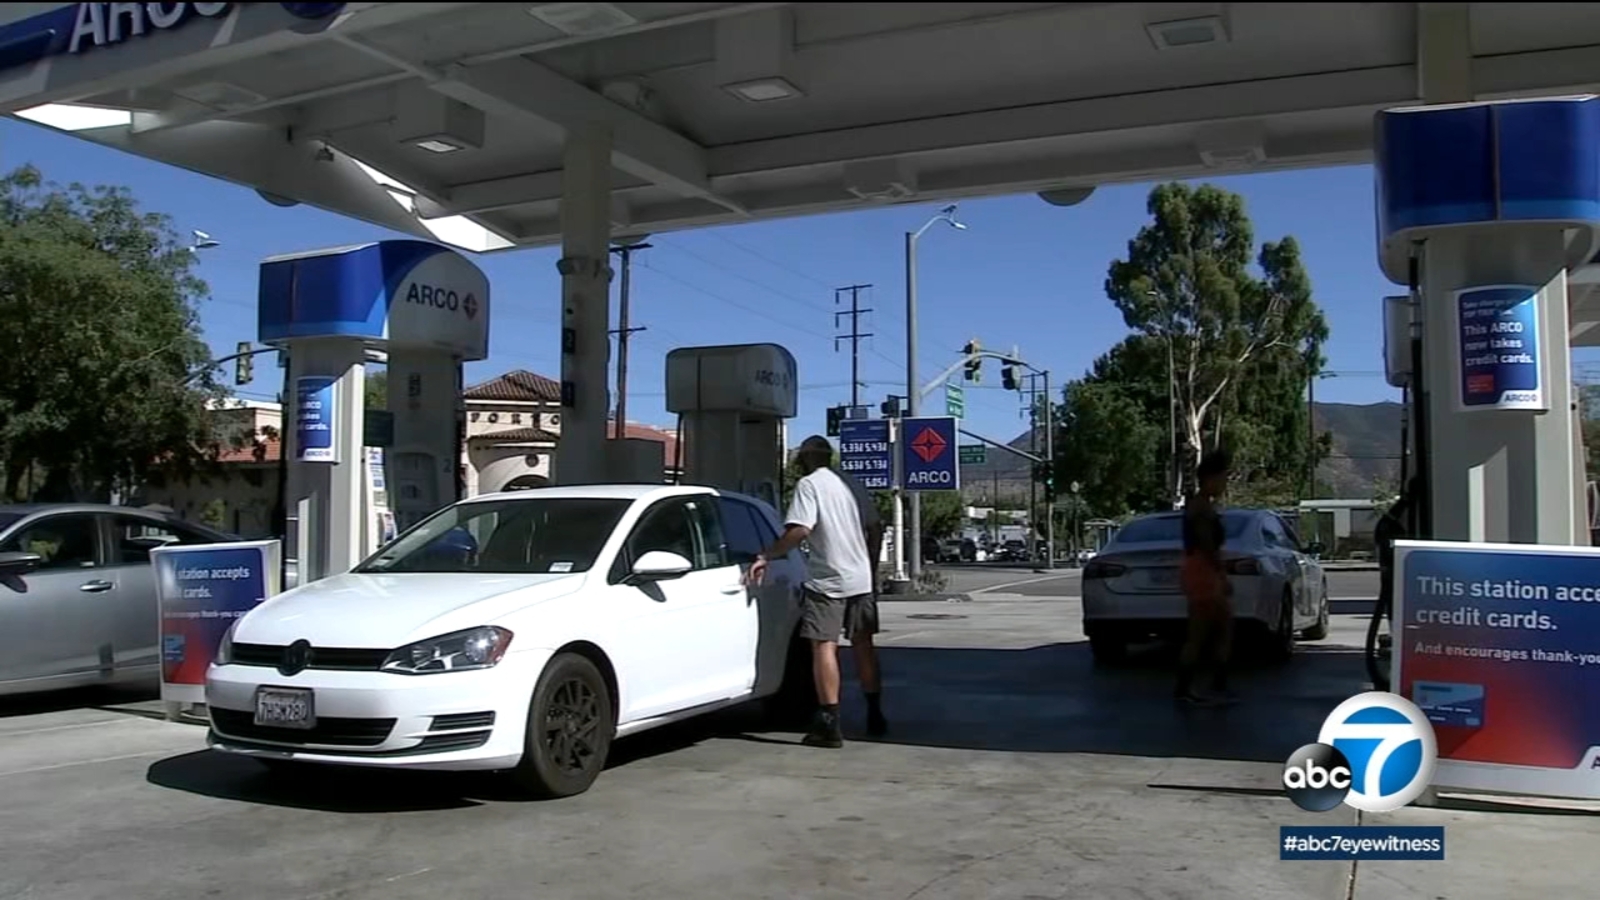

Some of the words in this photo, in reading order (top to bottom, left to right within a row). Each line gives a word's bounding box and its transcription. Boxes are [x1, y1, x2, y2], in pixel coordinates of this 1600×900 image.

[69, 3, 226, 52] ARC
[406, 282, 459, 311] ARCO
[1463, 323, 1487, 336] This
[1490, 321, 1523, 333] ARCO
[1465, 342, 1488, 351] now
[1491, 337, 1523, 349] takes
[1466, 353, 1498, 366] credit
[1500, 352, 1534, 364] cards.
[1504, 394, 1530, 402] ARCO
[908, 470, 951, 484] ARCO
[211, 566, 250, 580] accepts
[184, 586, 213, 598] cards.
[1416, 575, 1465, 596] This
[1470, 579, 1549, 600] station
[1416, 606, 1481, 626] credit
[1487, 610, 1558, 631] cards.
[1414, 642, 1442, 655] And
[1444, 645, 1528, 662] encourages
